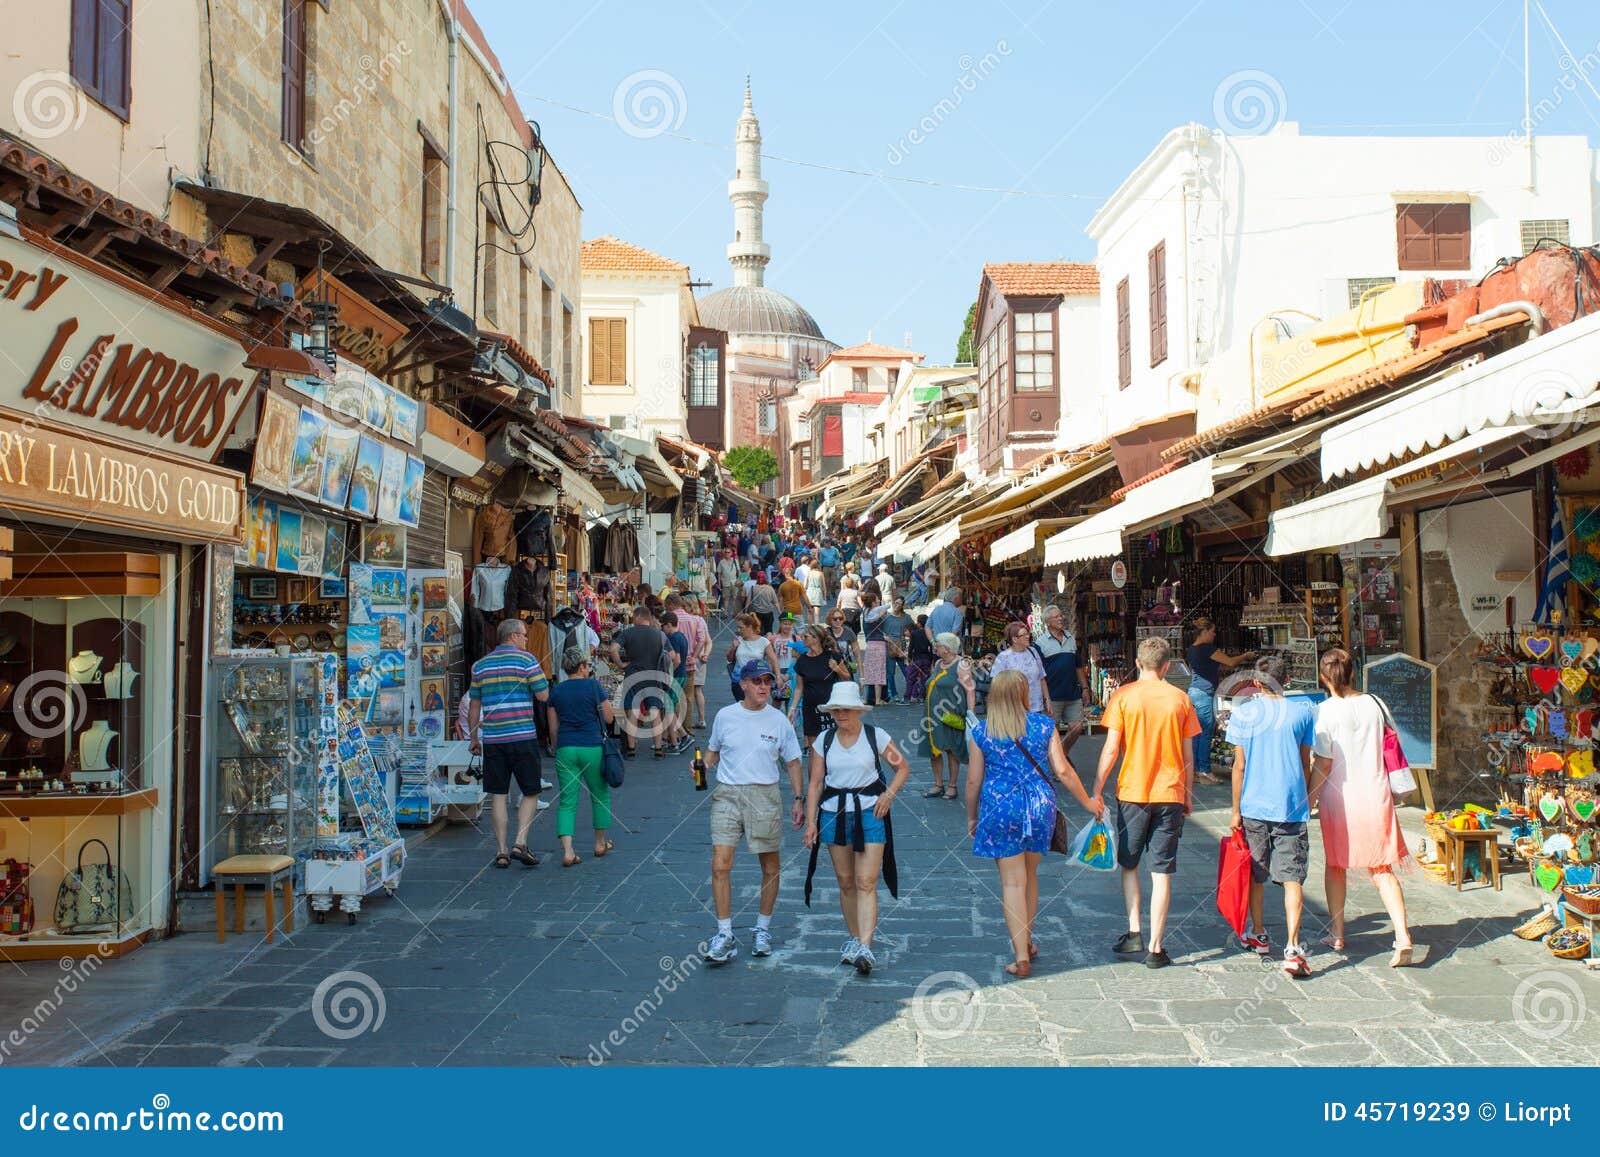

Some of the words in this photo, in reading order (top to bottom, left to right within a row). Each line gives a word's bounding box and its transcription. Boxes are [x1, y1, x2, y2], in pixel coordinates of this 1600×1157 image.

[23, 316, 243, 448] LAMBROS
[47, 442, 169, 514] LAMBROS
[178, 475, 236, 525] GOLD
[1475, 595, 1496, 604] WI-FI
